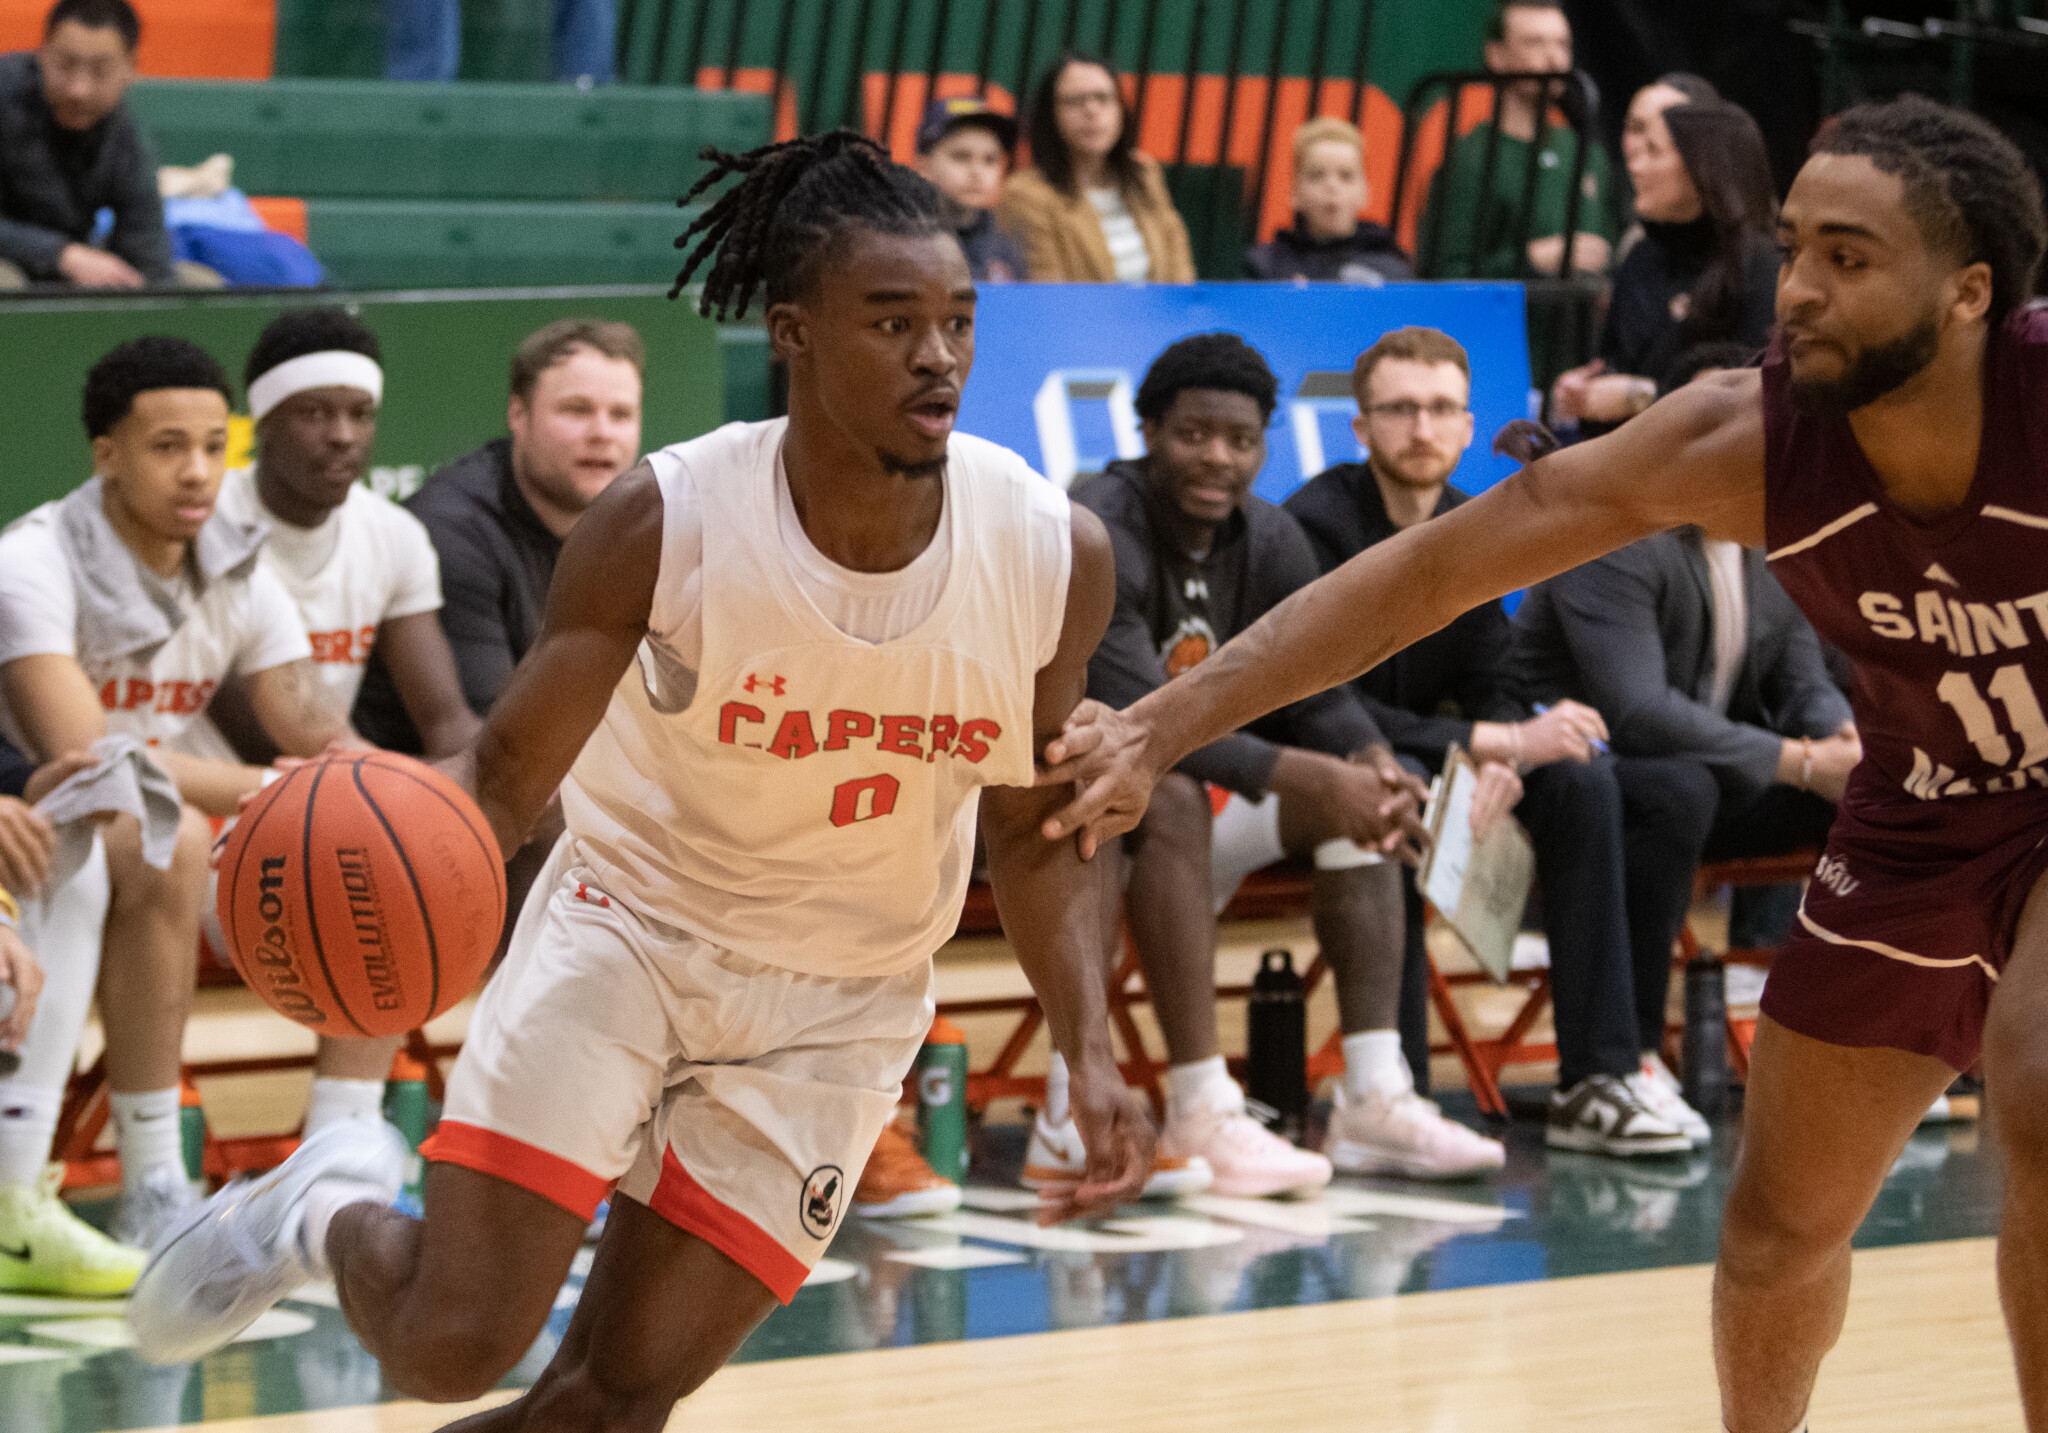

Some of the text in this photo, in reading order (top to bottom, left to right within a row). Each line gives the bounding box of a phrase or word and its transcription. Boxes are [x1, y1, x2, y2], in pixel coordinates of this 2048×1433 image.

[1857, 590, 2048, 657] SAINT
[99, 678, 216, 716] APERS
[1936, 663, 2048, 770] 11
[719, 700, 1002, 764] CAPERS
[829, 773, 900, 828] 0
[256, 855, 327, 1024] Wilson
[336, 847, 399, 1012] EVOLUTION
